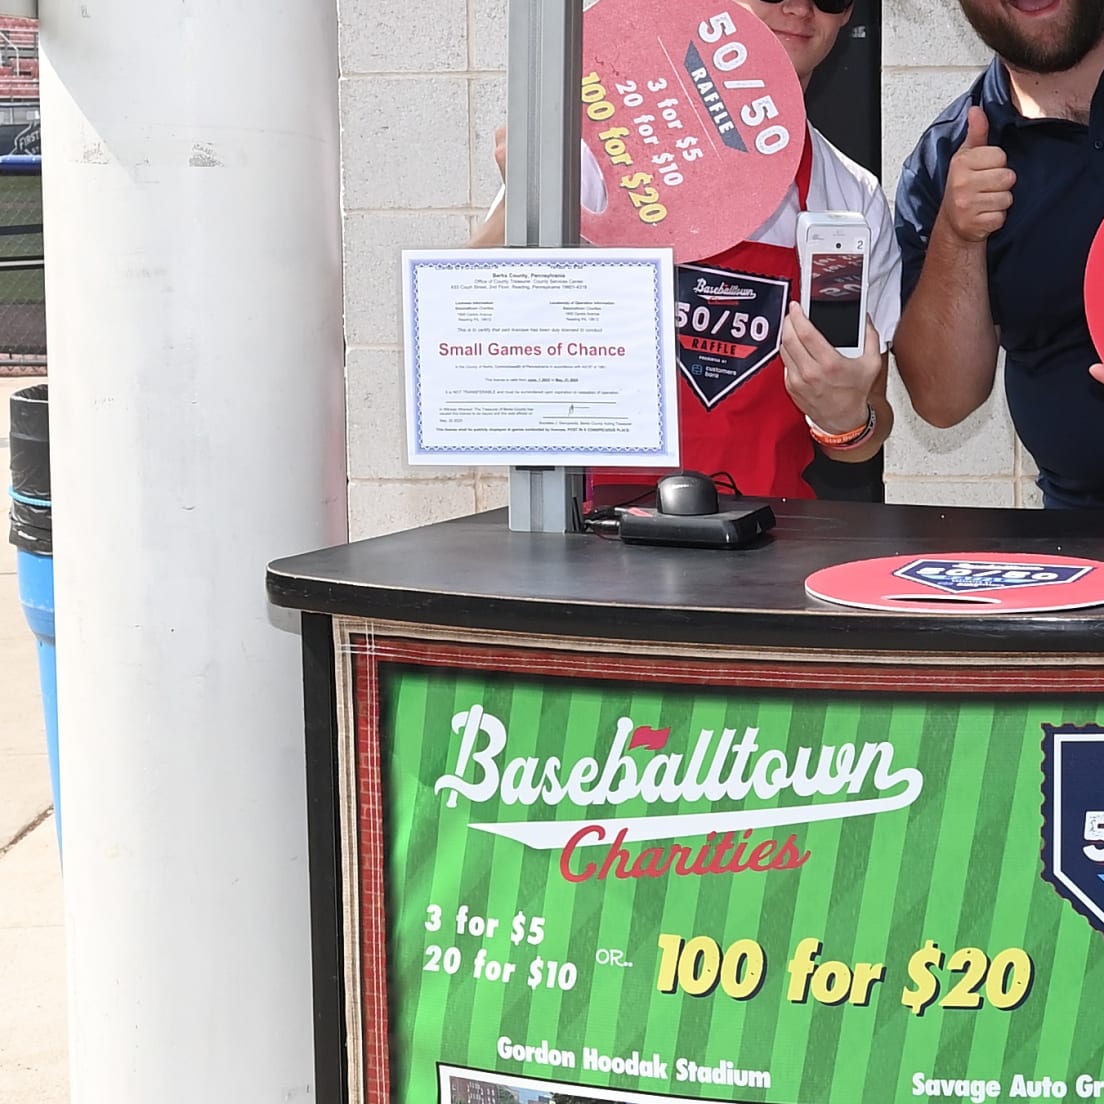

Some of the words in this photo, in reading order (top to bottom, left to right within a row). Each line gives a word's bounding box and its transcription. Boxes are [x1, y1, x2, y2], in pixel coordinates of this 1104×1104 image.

[647, 77, 668, 93] 3
[691, 66, 735, 135] RAFFLE
[697, 11, 790, 156] 50/50
[615, 79, 644, 107] 20
[632, 114, 660, 146] for
[651, 152, 685, 187] $10
[656, 98, 684, 130] for
[581, 71, 616, 122] 100
[599, 126, 634, 166] for
[619, 171, 668, 224] $20
[675, 136, 704, 162] $5
[857, 240, 864, 250] 2
[675, 301, 770, 342] 50/50
[438, 342, 482, 357] Small
[487, 342, 542, 357] Games
[547, 342, 563, 357] of
[567, 342, 626, 357] Chance
[691, 338, 737, 356] RAFFLE
[434, 703, 924, 809] Baseballtown
[560, 824, 812, 884] Charities
[424, 904, 444, 932] 3
[455, 906, 499, 940] for
[511, 910, 546, 946] $5
[422, 945, 461, 976] 20
[473, 948, 516, 984] for
[528, 953, 577, 993] $10
[656, 933, 768, 1001] 100
[786, 937, 885, 1006] for
[900, 939, 1034, 1016] $20
[497, 1035, 576, 1069] Gordon
[583, 1046, 668, 1083] Hoodak
[676, 1056, 771, 1089] Stadium
[912, 1072, 1001, 1103] Savage
[1009, 1073, 1068, 1098] Auto
